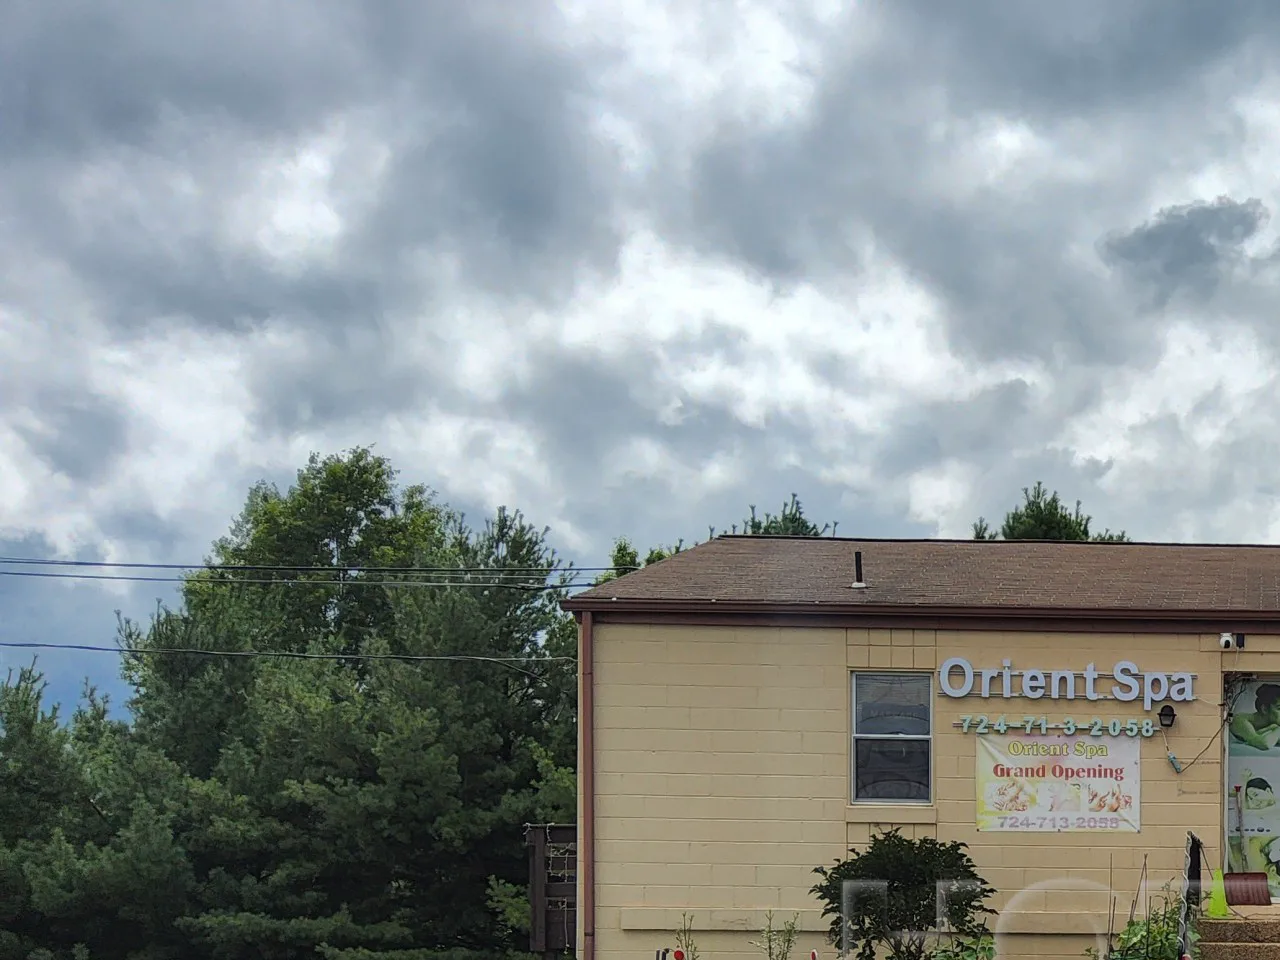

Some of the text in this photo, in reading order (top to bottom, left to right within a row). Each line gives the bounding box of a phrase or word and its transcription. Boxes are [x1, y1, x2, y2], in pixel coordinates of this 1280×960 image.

[939, 657, 1194, 711] Orient Spa
[1007, 740, 1109, 760] Orient Spa
[992, 763, 1126, 782] Grand Opening
[997, 815, 1121, 830] 724-713-2058
